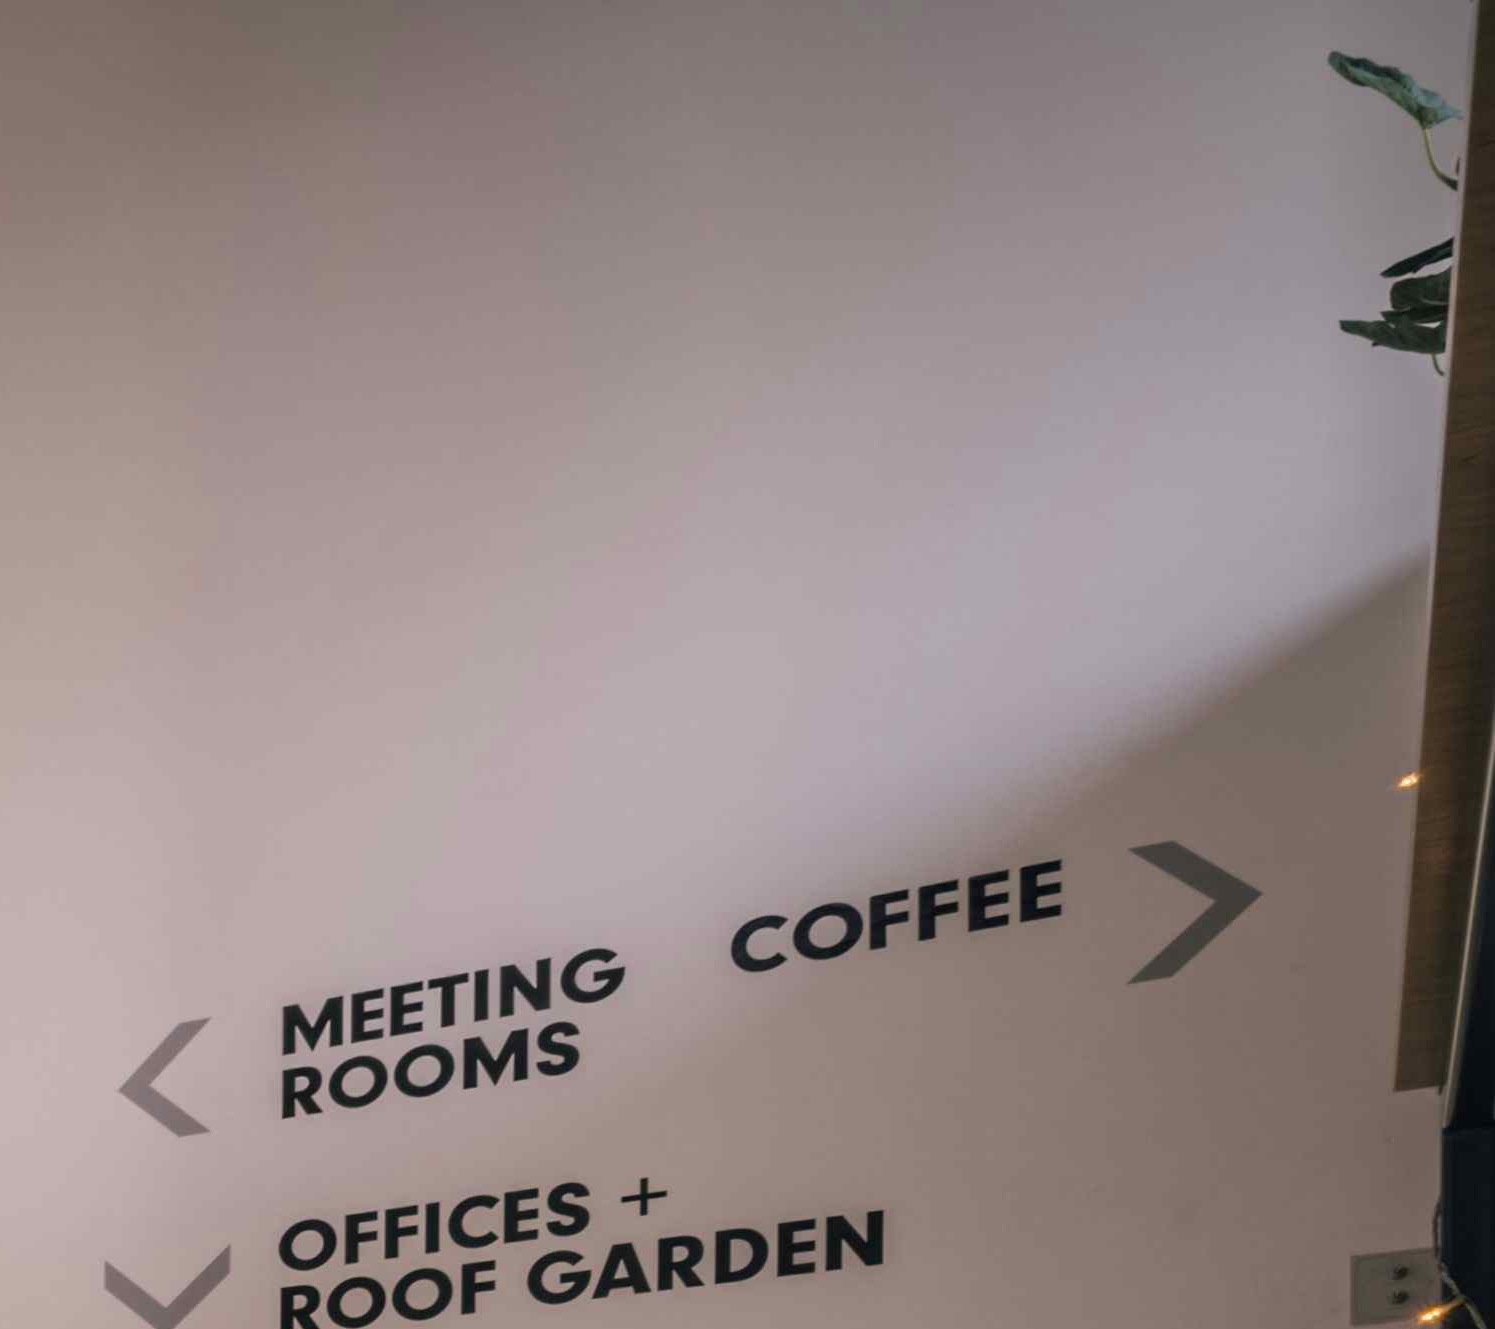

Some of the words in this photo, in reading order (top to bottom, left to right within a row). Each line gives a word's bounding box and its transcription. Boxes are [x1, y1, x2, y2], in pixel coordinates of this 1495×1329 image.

[730, 858, 1065, 975] COFFEE
[281, 946, 627, 1056] MEETING
[281, 1020, 582, 1120] ROOMS
[277, 1180, 593, 1273] OFFICES
[620, 1177, 669, 1217] +
[526, 1209, 887, 1307] GARDEN
